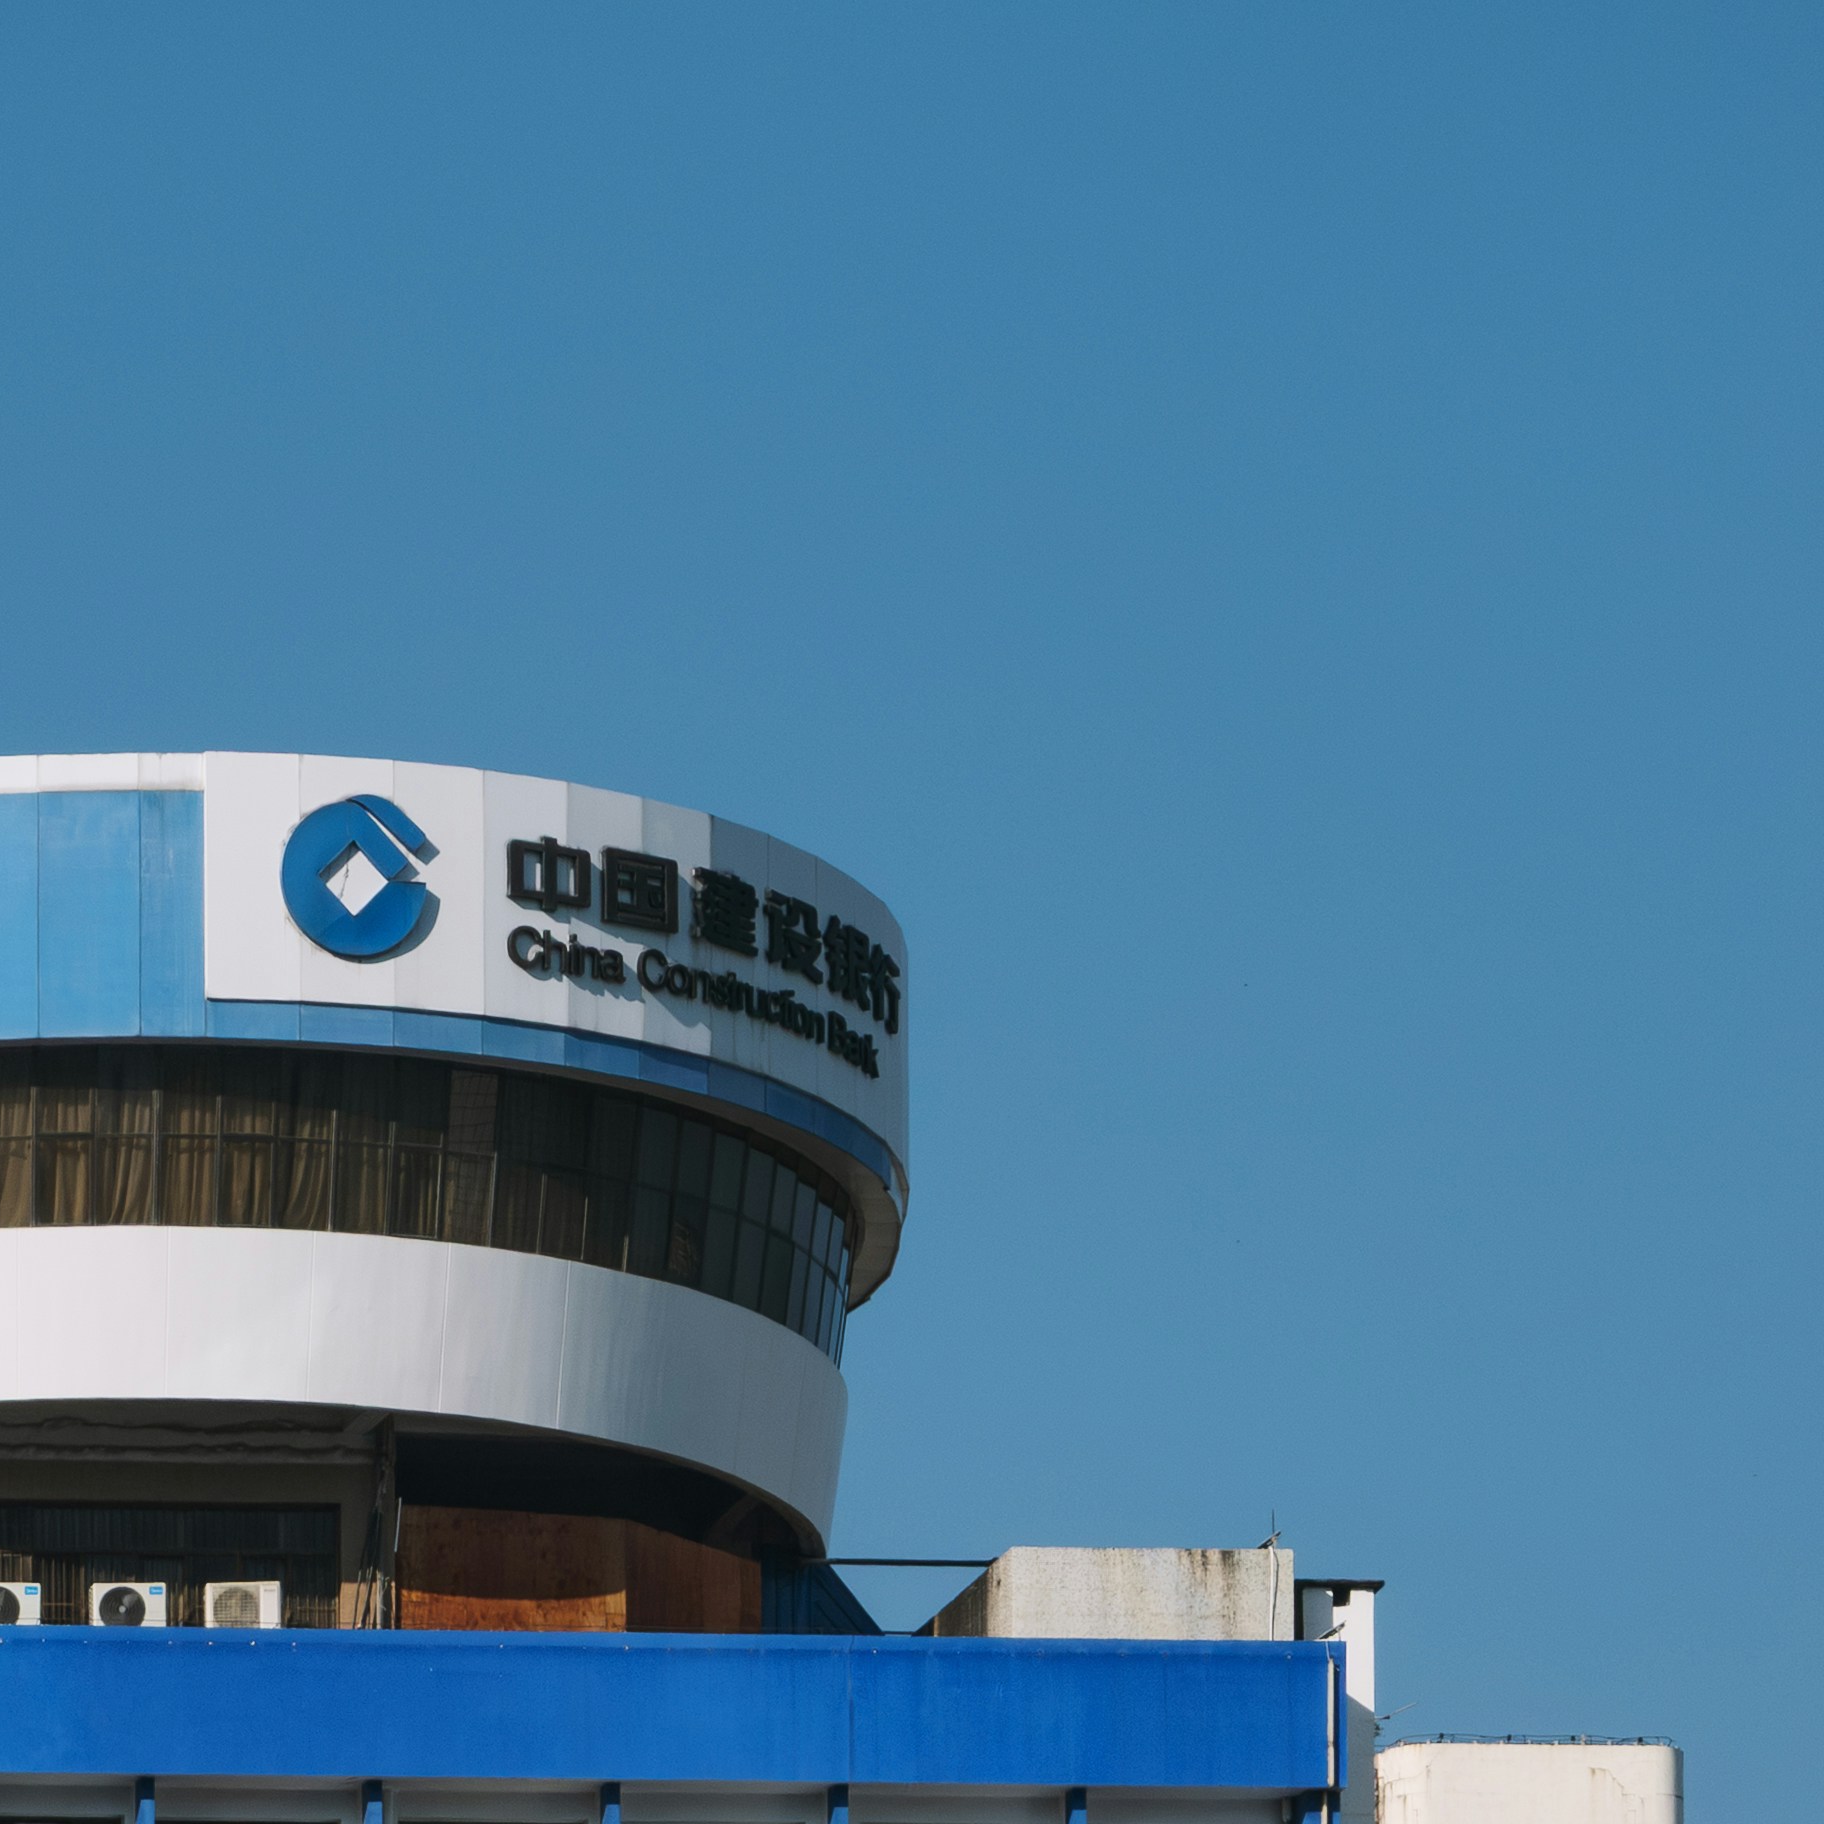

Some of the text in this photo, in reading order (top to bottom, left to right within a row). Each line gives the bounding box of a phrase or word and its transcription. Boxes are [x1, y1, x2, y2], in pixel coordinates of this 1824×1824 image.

[506, 836, 900, 1035] 中国建设银行
[507, 926, 880, 1080] China Construction Bank
